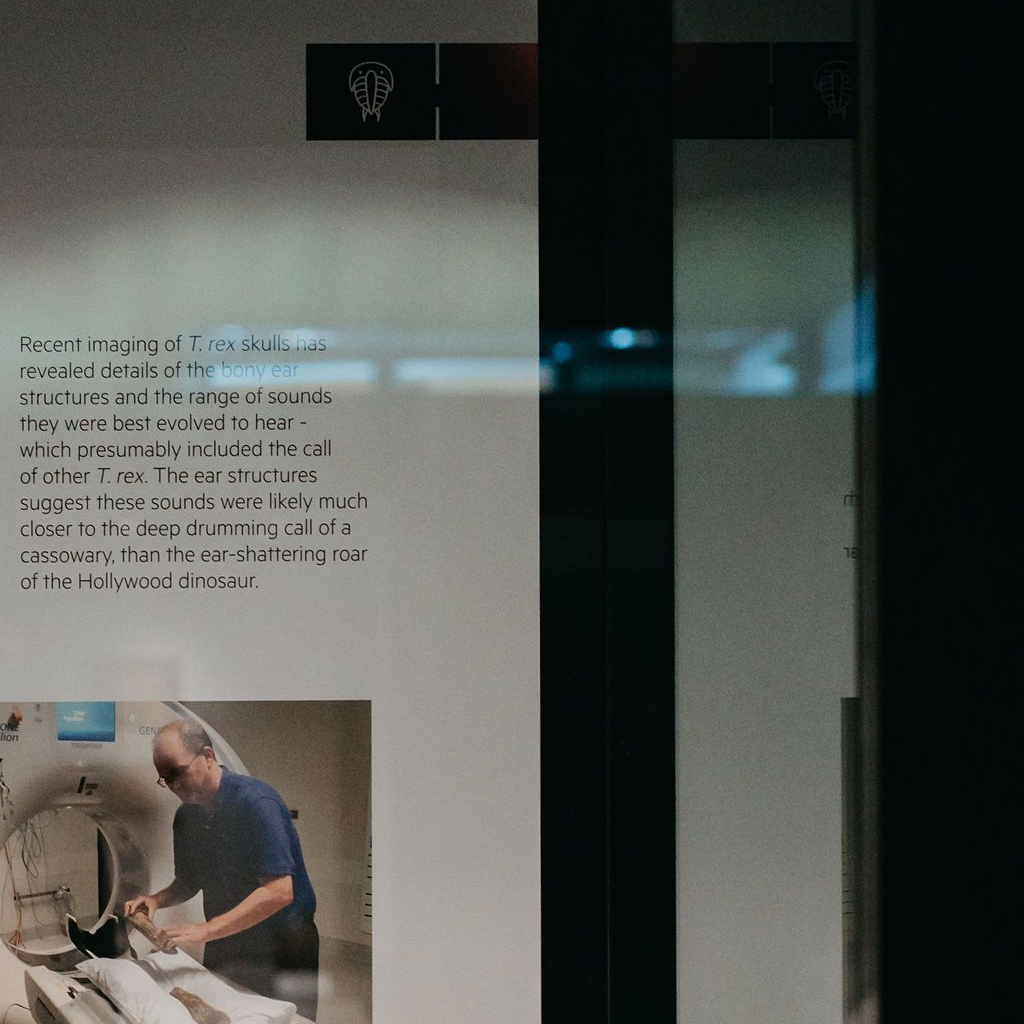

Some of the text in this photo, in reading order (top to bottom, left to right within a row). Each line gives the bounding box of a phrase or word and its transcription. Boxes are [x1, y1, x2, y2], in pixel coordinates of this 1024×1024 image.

[20, 334, 327, 357] Recent imaging of T. rex skulls has
[20, 361, 299, 380] revealed details of the bony ear
[19, 386, 333, 409] structures and the range of sounds
[19, 414, 60, 436] they
[64, 418, 107, 432] were
[113, 413, 151, 432] best
[156, 413, 225, 432] evolved
[230, 415, 249, 431] to
[255, 413, 295, 431] hear
[19, 438, 332, 462] which presumably included the call
[20, 466, 318, 485] of other T. rex. The ear structures
[20, 491, 368, 515] suggest these sounds were likely much
[20, 517, 351, 540] closer to the deep drumming call of a
[20, 544, 369, 567] cassowary, than the ear-shattering roar
[20, 571, 259, 594] of the Hollywood dinosaur.
